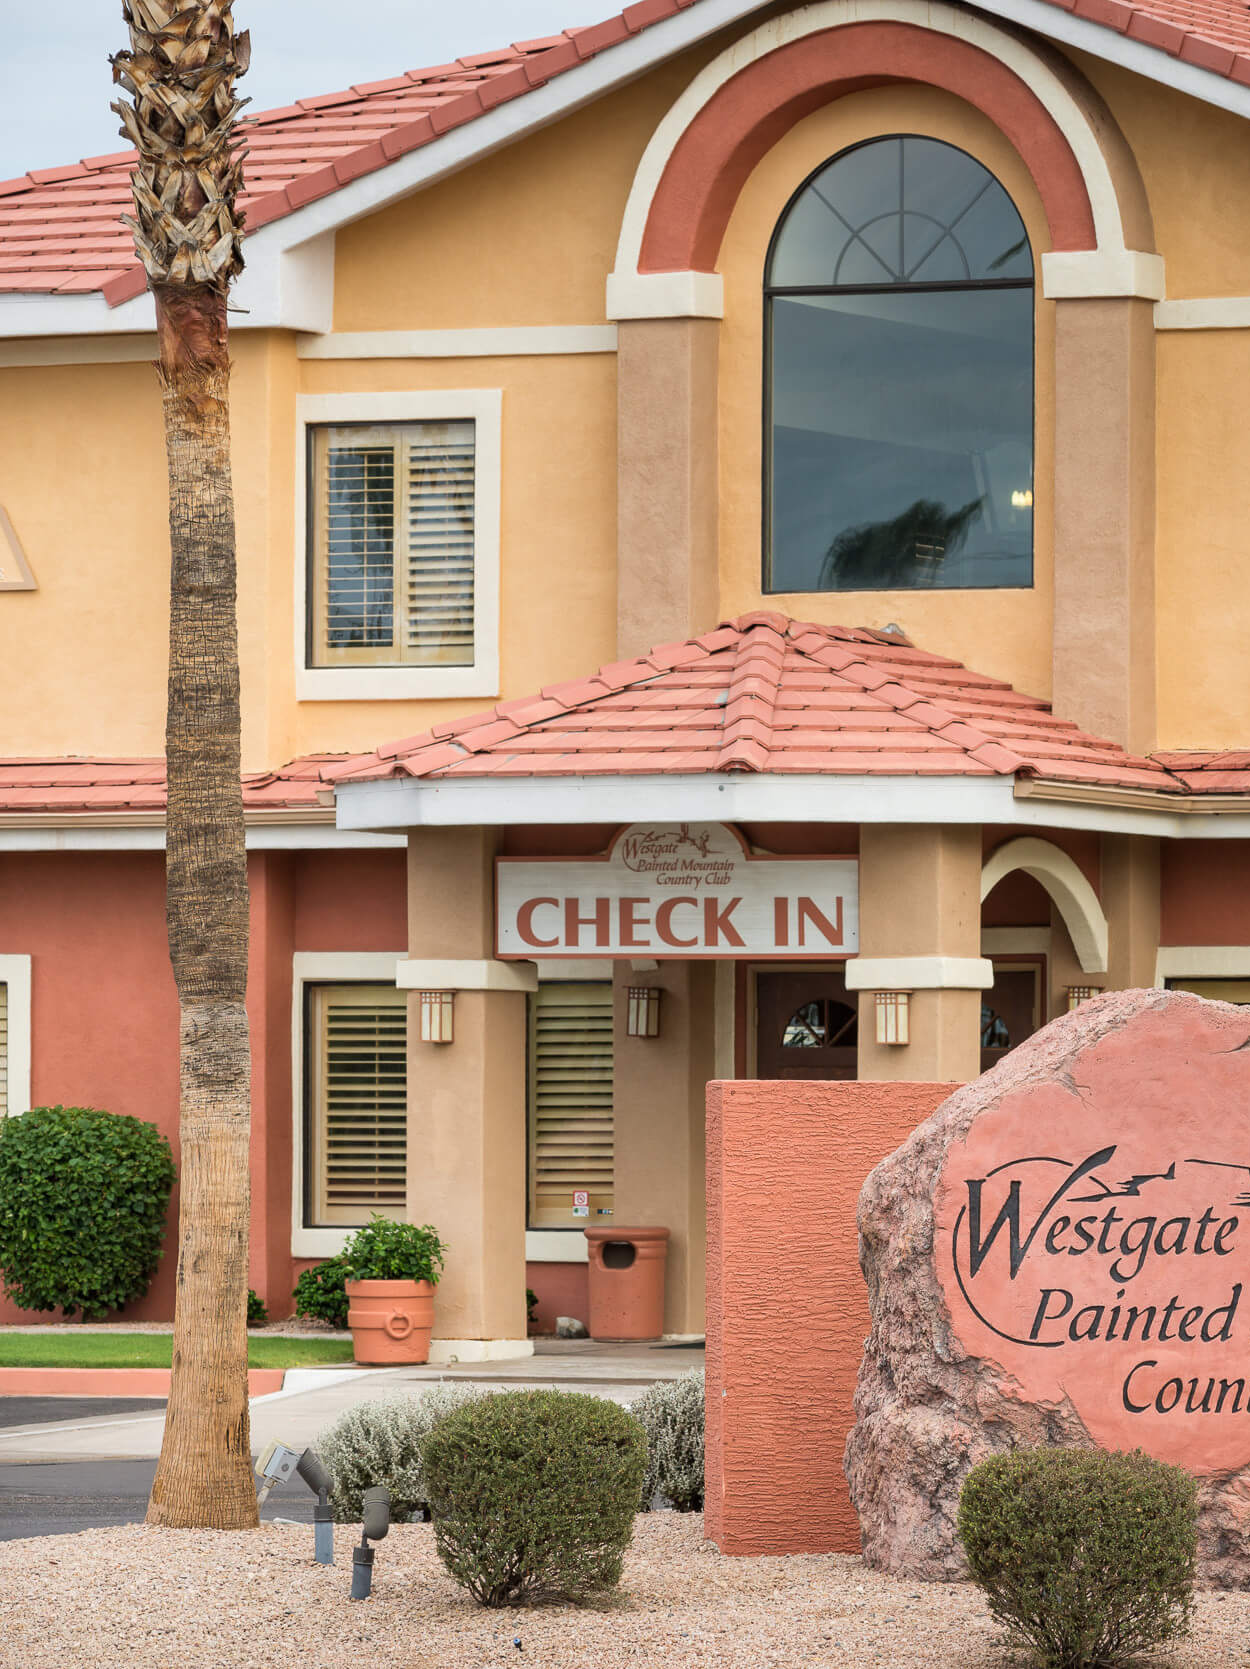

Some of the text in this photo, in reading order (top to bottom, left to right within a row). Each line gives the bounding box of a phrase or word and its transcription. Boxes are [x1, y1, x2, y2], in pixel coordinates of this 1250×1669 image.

[624, 831, 678, 859] Westgate
[638, 858, 735, 872] Painted Mountain
[656, 871, 731, 891] Country Club
[516, 896, 844, 948] CHECK IN
[963, 1145, 1239, 1283] Westgate
[1030, 1282, 1243, 1344] Painted
